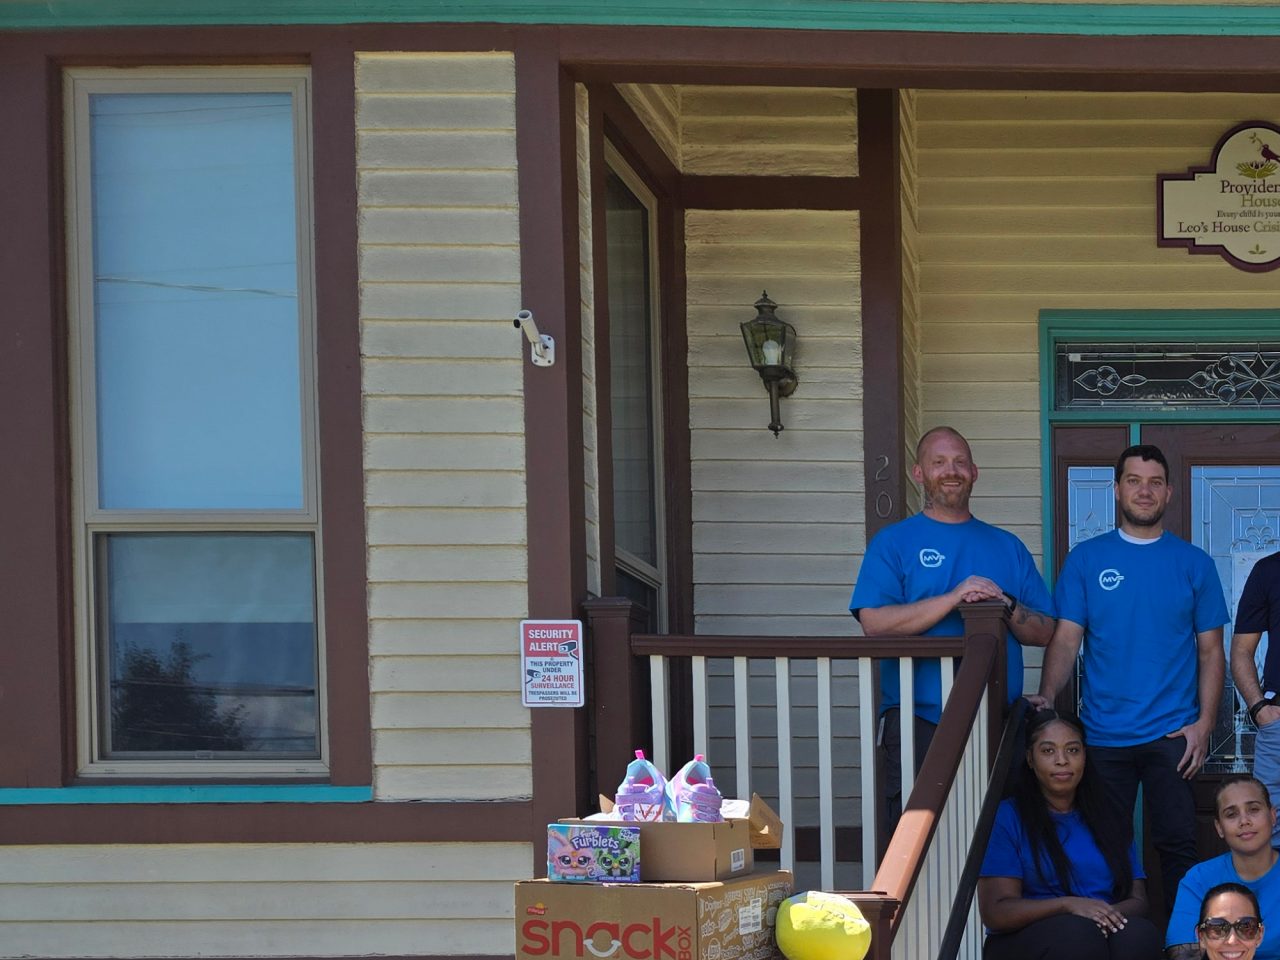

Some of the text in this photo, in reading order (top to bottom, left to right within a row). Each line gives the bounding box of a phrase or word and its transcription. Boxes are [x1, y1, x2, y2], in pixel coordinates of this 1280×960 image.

[1217, 210, 1280, 219] Every child is your
[1178, 221, 1208, 233] Leo's
[1212, 221, 1250, 233] House
[528, 629, 573, 639] SECURITY
[529, 642, 558, 651] ALERT
[572, 835, 619, 850] Furblets
[521, 917, 677, 960] snack
